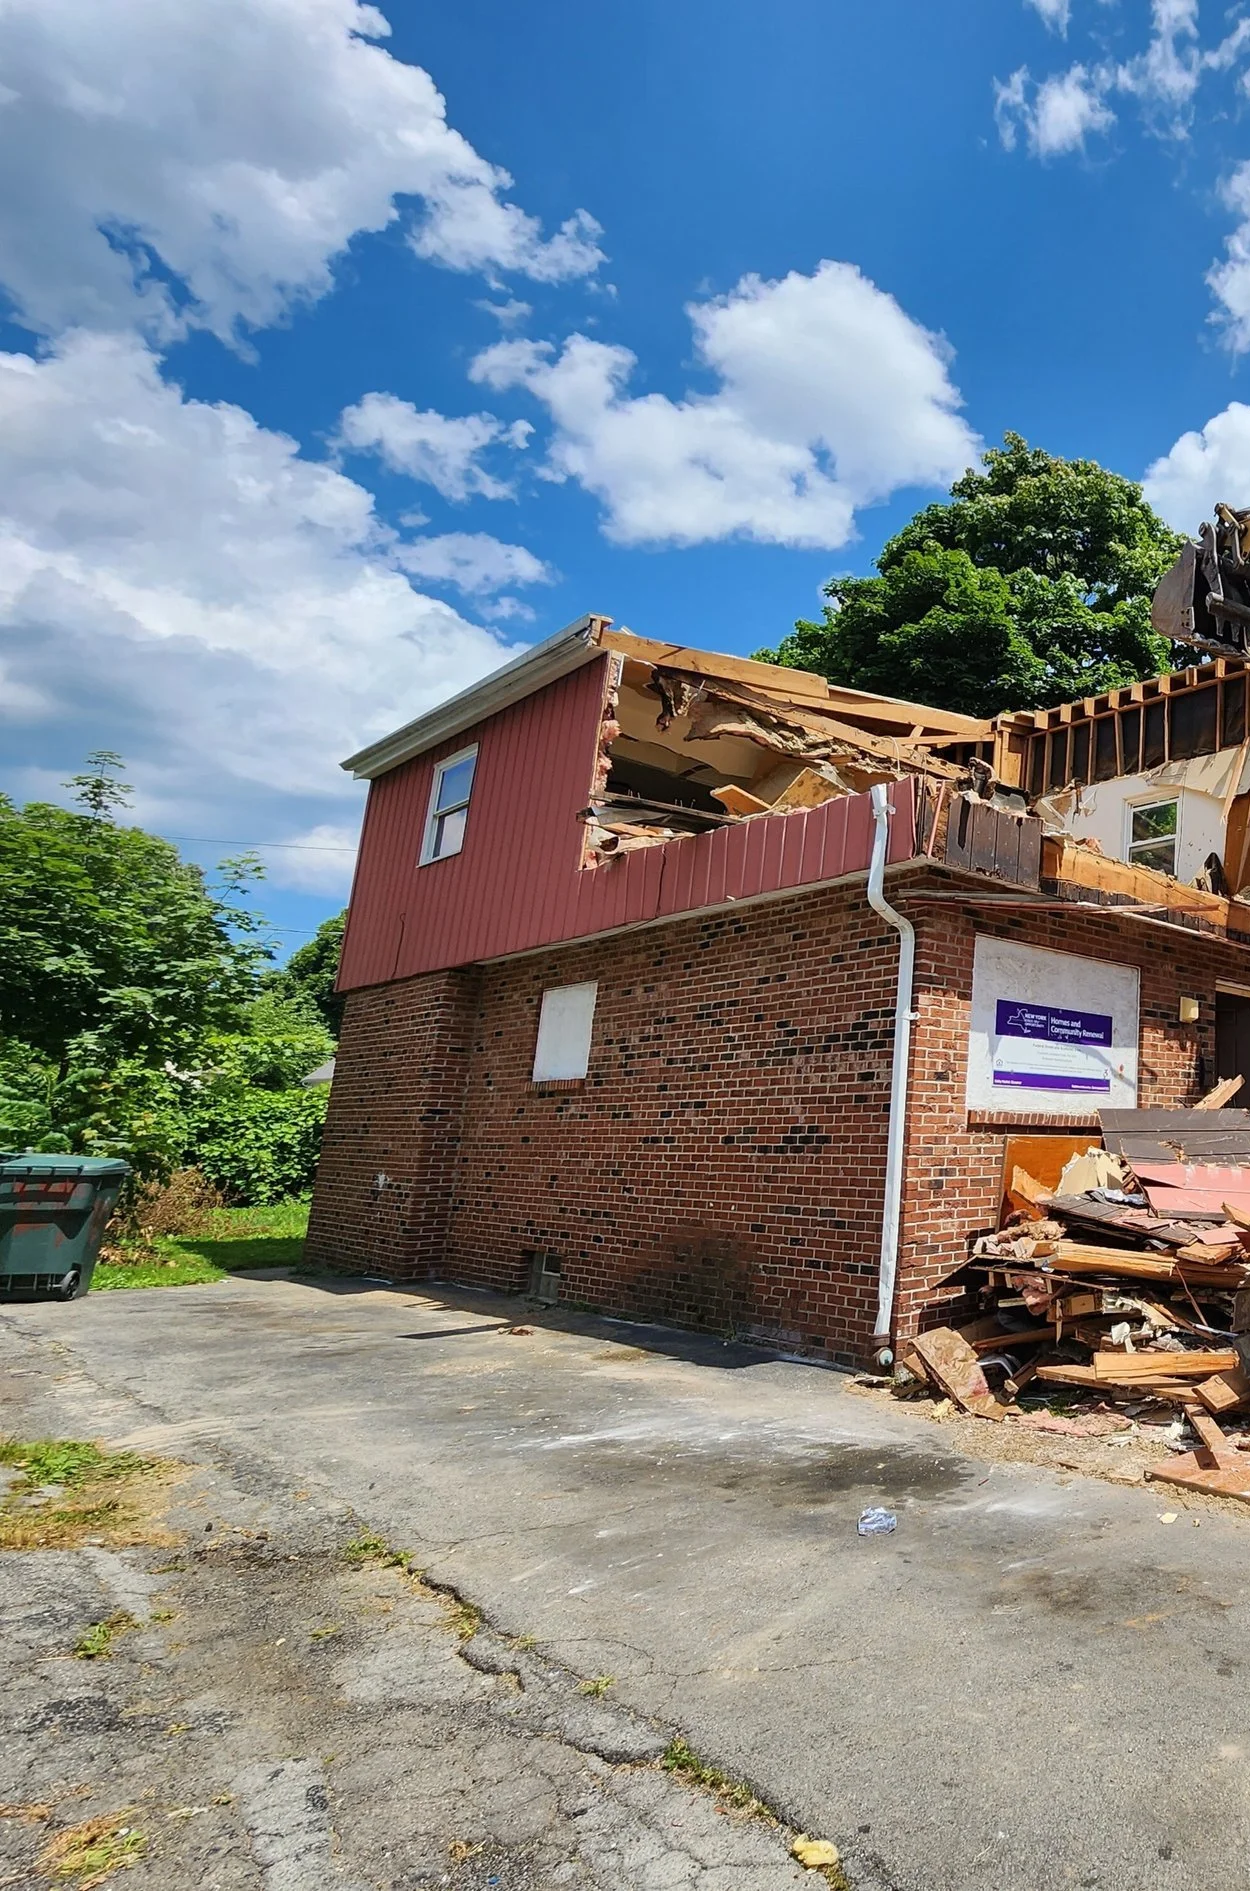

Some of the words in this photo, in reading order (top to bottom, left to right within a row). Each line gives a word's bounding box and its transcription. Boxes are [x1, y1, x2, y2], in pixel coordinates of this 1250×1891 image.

[1050, 1017, 1070, 1027] Homes
[1070, 1020, 1081, 1028] and
[1050, 1025, 1082, 1038] Community
[1082, 1029, 1104, 1039] Renewal
